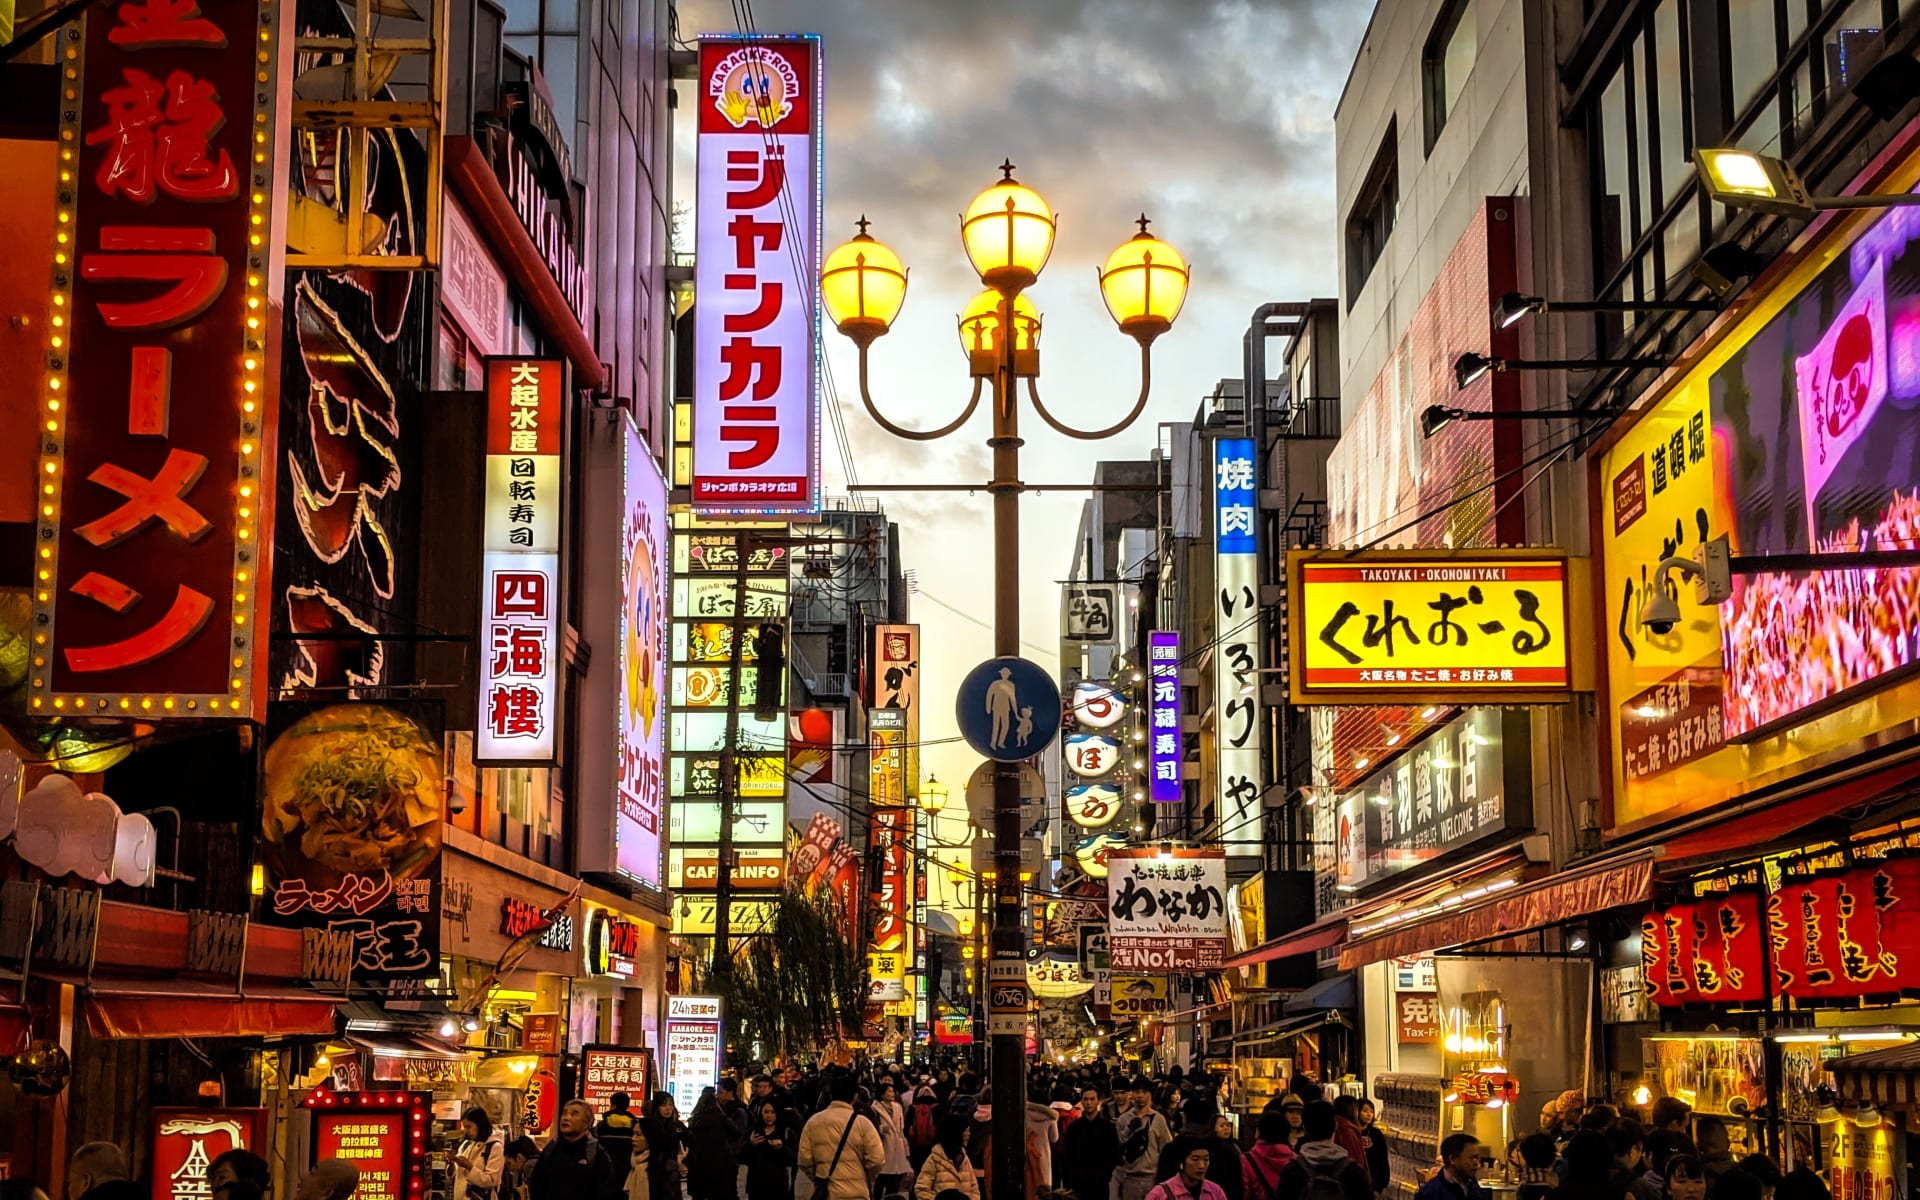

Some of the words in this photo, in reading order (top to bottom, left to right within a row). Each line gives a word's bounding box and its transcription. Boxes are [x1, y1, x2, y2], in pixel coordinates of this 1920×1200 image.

[718, 145, 784, 470] ジャンカラ
[510, 363, 539, 453] 大起水産
[1651, 409, 1706, 497] 道頓堀
[508, 457, 537, 548] 回転寿司
[700, 481, 798, 493] ジャンボカラオケ広場
[1218, 457, 1255, 536] 焼肉
[706, 546, 770, 563] ぼて屋
[752, 582, 778, 592] DININ
[1070, 598, 1107, 629] 牛角
[1319, 584, 1551, 665] くれおーる
[487, 569, 550, 740] 四海樓
[1360, 670, 1408, 682] 大阪名物
[1221, 585, 1258, 820] いろりや
[1154, 682, 1177, 781] 元禄寿司
[1625, 704, 1722, 781] たこ焼・お好み焼
[1440, 807, 1474, 844] WELCOME
[273, 866, 393, 916] ラーメン
[1111, 876, 1224, 923] わなか
[699, 906, 764, 924] ZZA
[877, 956, 895, 973] 薬
[1133, 949, 1175, 968] No.1
[672, 1000, 717, 1015] 24h営業中
[587, 1069, 643, 1084] 回転寿司
[591, 1055, 642, 1069] 大起水産
[1832, 1133, 1850, 1159] 2F
